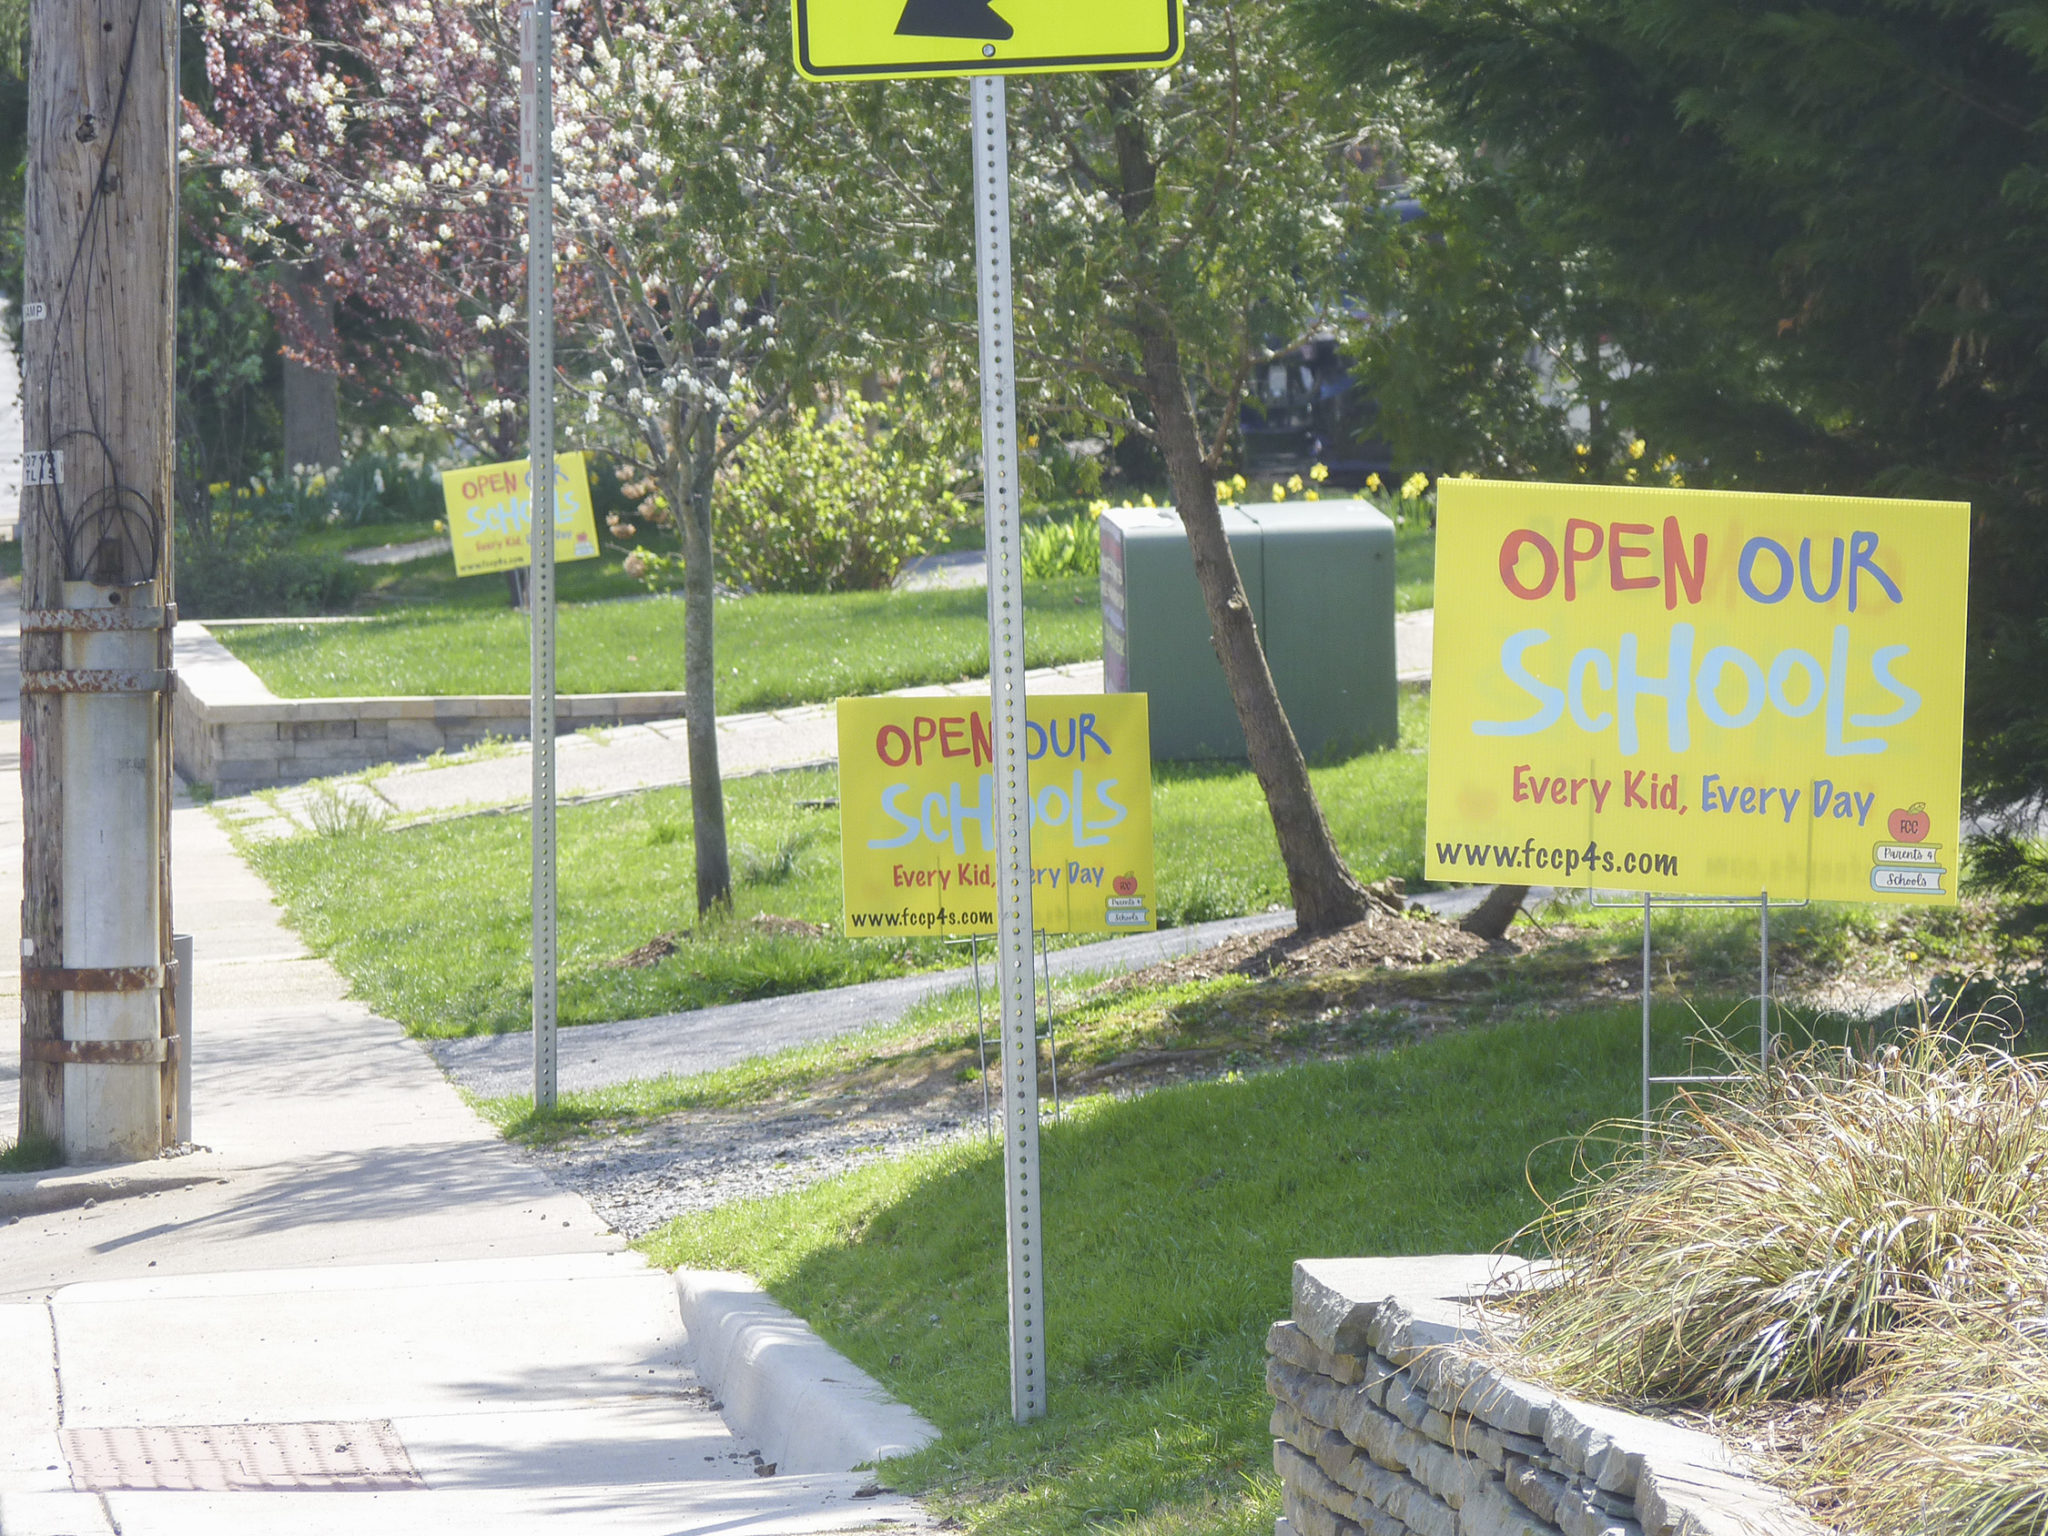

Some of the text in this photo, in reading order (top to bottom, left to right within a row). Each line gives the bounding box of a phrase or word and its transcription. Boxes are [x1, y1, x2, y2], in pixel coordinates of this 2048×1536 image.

[462, 470, 517, 500] OPEN
[1499, 515, 1904, 613] OPEN OUR
[1471, 622, 1922, 756] SCHOOLS
[876, 711, 993, 767] OPEN
[867, 769, 1127, 855] SCHOLS
[1512, 764, 1875, 826] Every Kid, Every Day
[1900, 820, 1918, 834] FCC
[1436, 837, 1678, 877] www.fccp4s.com
[1884, 847, 1922, 860] Parents
[893, 864, 951, 891] Every
[957, 863, 996, 888] Kid,
[1068, 861, 1104, 886] Day
[1886, 872, 1927, 887] Schools
[852, 907, 993, 929] www.fccp4s.com
